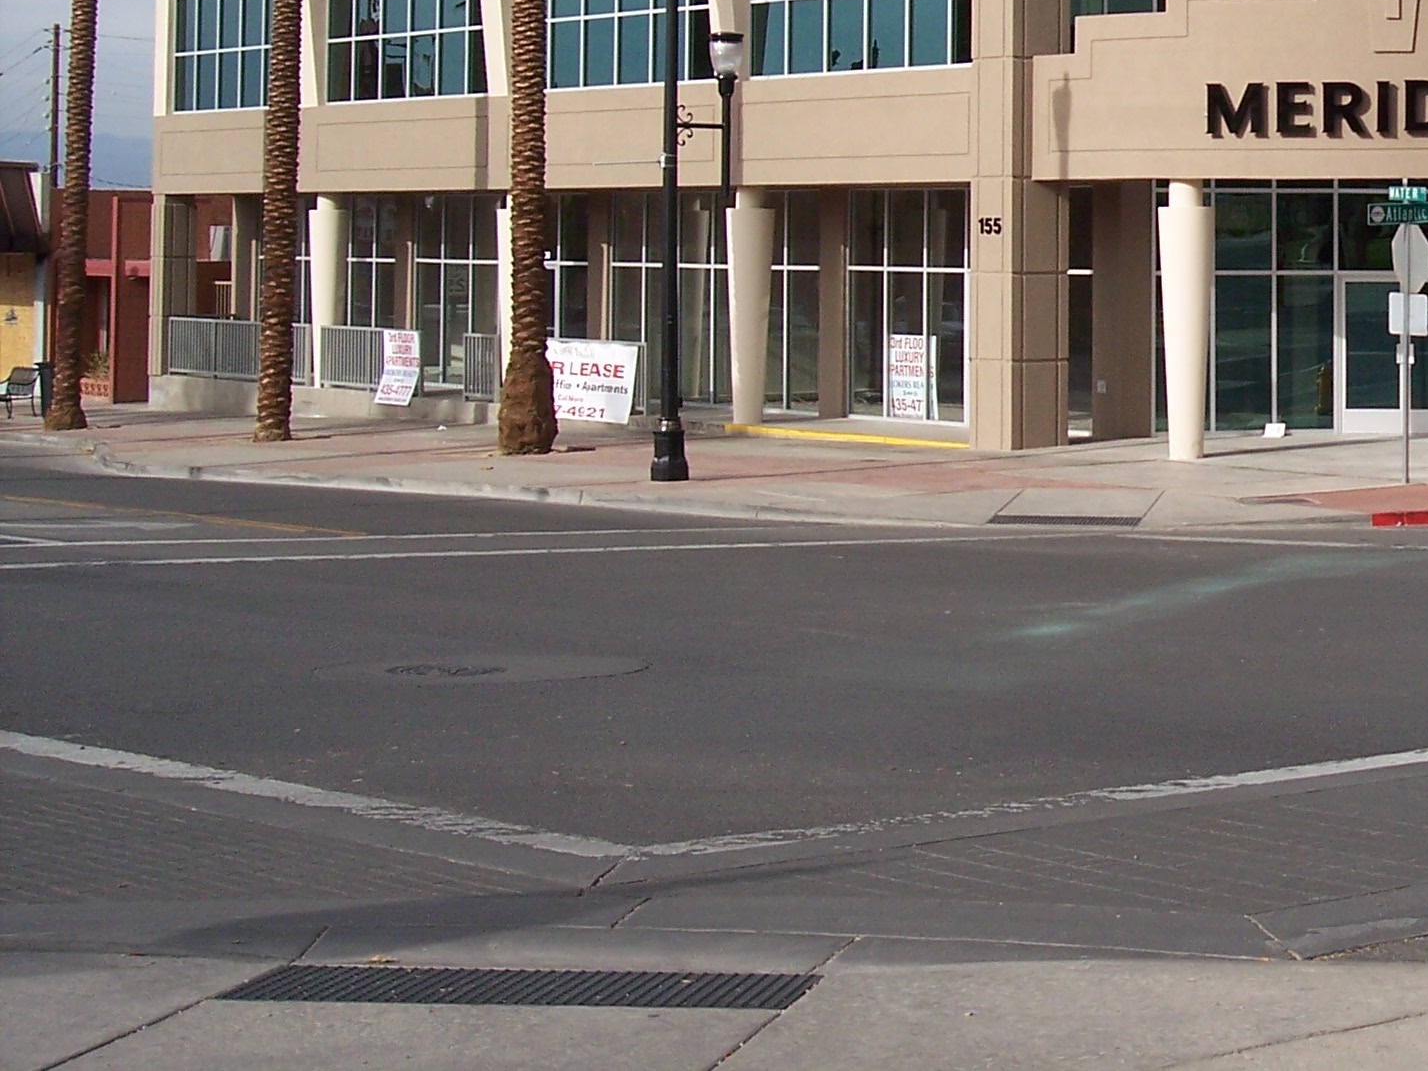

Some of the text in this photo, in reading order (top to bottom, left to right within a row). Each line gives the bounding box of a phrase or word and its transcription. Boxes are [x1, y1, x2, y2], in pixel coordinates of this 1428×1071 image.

[1389, 187, 1418, 199] WATER
[1386, 206, 1427, 222] Atlantic
[978, 217, 1002, 235] 155
[890, 337, 924, 349] 3rd FLOO
[895, 350, 924, 363] LUXURY
[569, 362, 626, 379] LEASE
[582, 381, 629, 395] Apartments
[554, 405, 607, 419] 7-4921
